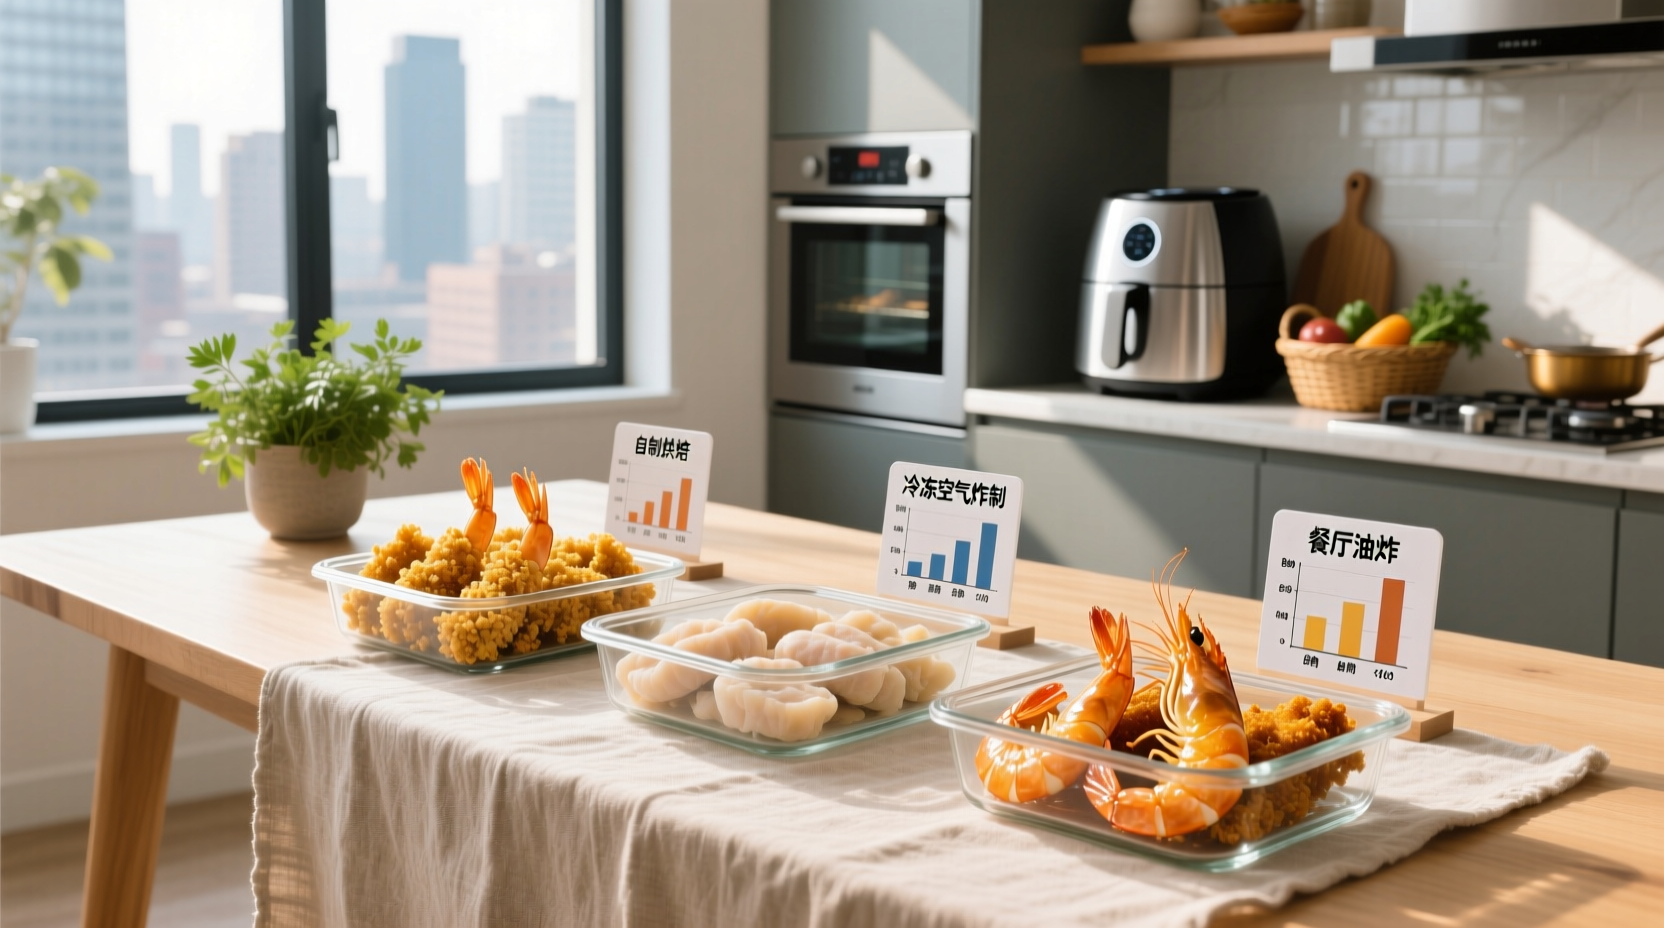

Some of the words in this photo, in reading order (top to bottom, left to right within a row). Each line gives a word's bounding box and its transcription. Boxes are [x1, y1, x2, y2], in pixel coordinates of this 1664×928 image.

[902, 474, 1007, 509] 冷冻空气炸制
[1308, 526, 1401, 564] 餐厅油炸
